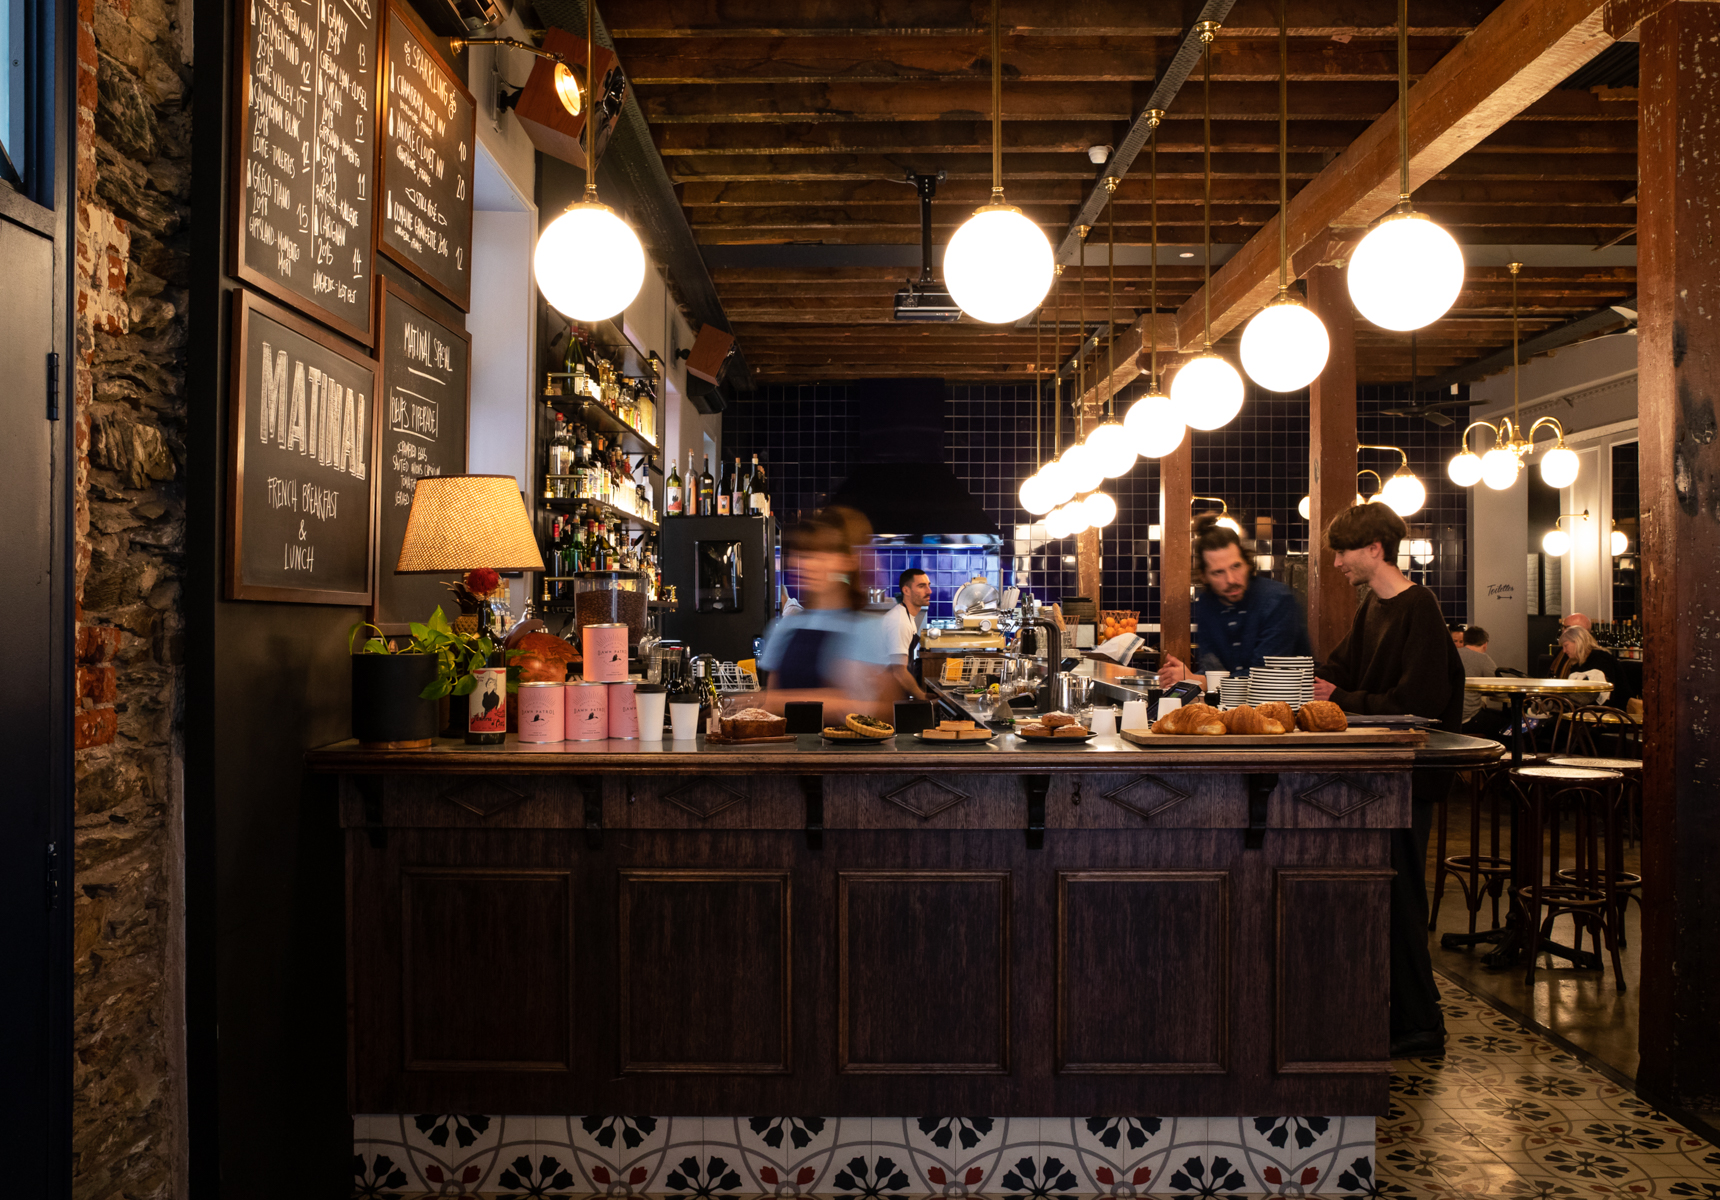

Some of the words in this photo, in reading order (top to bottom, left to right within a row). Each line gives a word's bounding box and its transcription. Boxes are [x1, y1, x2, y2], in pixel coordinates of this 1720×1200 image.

[256, 33, 274, 67] 2018
[258, 6, 299, 66] VERMENTINO
[301, 60, 311, 85] 12
[325, 29, 340, 56] 2018
[327, 3, 348, 45] GAMAY
[357, 42, 366, 67] 13
[272, 70, 293, 107] VALLEY
[412, 45, 448, 107] SPARKLING
[253, 111, 269, 137] 2018
[323, 75, 343, 117] SYRAH
[355, 114, 364, 136] 15
[424, 102, 437, 130] BRUT
[437, 116, 446, 138] NV
[458, 141, 467, 163] 10
[301, 140, 310, 167] 12
[321, 144, 336, 174] GSM
[357, 172, 366, 197] 11
[396, 111, 416, 152] ANDRÉ
[435, 154, 445, 181] NV
[456, 174, 466, 200] 20
[252, 161, 272, 196] GRECO
[273, 178, 291, 210] FIANO
[296, 202, 309, 228] 15
[252, 191, 268, 217] 2018
[416, 191, 428, 213] STILL
[352, 247, 362, 274] 14
[455, 246, 463, 271] 12
[404, 321, 433, 368] MATINAL
[433, 337, 454, 372] SPECIAL
[260, 340, 366, 481] MATINAL
[268, 476, 298, 512] FRENCH
[302, 482, 339, 522] BREAKFAST
[298, 519, 307, 541] &
[284, 543, 314, 573] LUNCH
[1486, 583, 1515, 597] Toilettes
